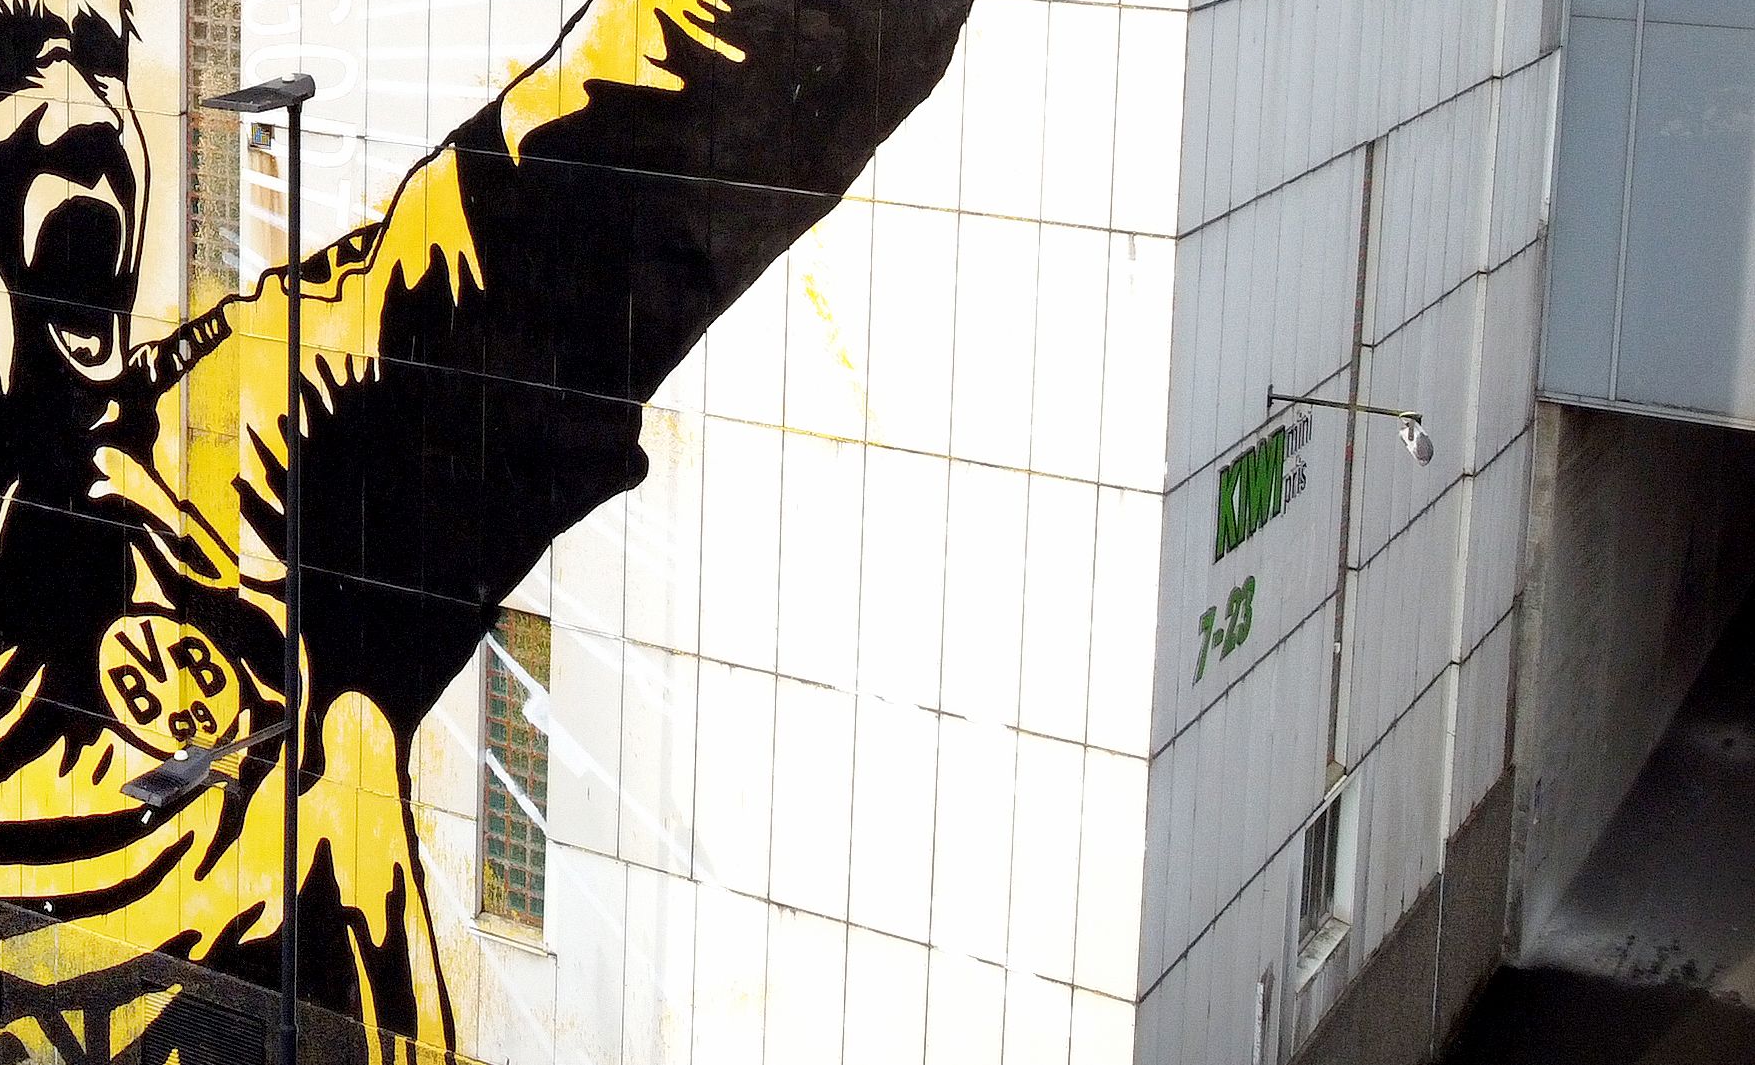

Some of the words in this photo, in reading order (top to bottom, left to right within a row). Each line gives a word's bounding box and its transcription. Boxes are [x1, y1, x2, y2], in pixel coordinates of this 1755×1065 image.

[1285, 409, 1314, 460] mini
[1213, 425, 1286, 565] KIWI
[1283, 457, 1309, 516] pris
[107, 618, 227, 727] BVB
[1192, 574, 1256, 687] 7-23
[167, 699, 219, 740] 09
